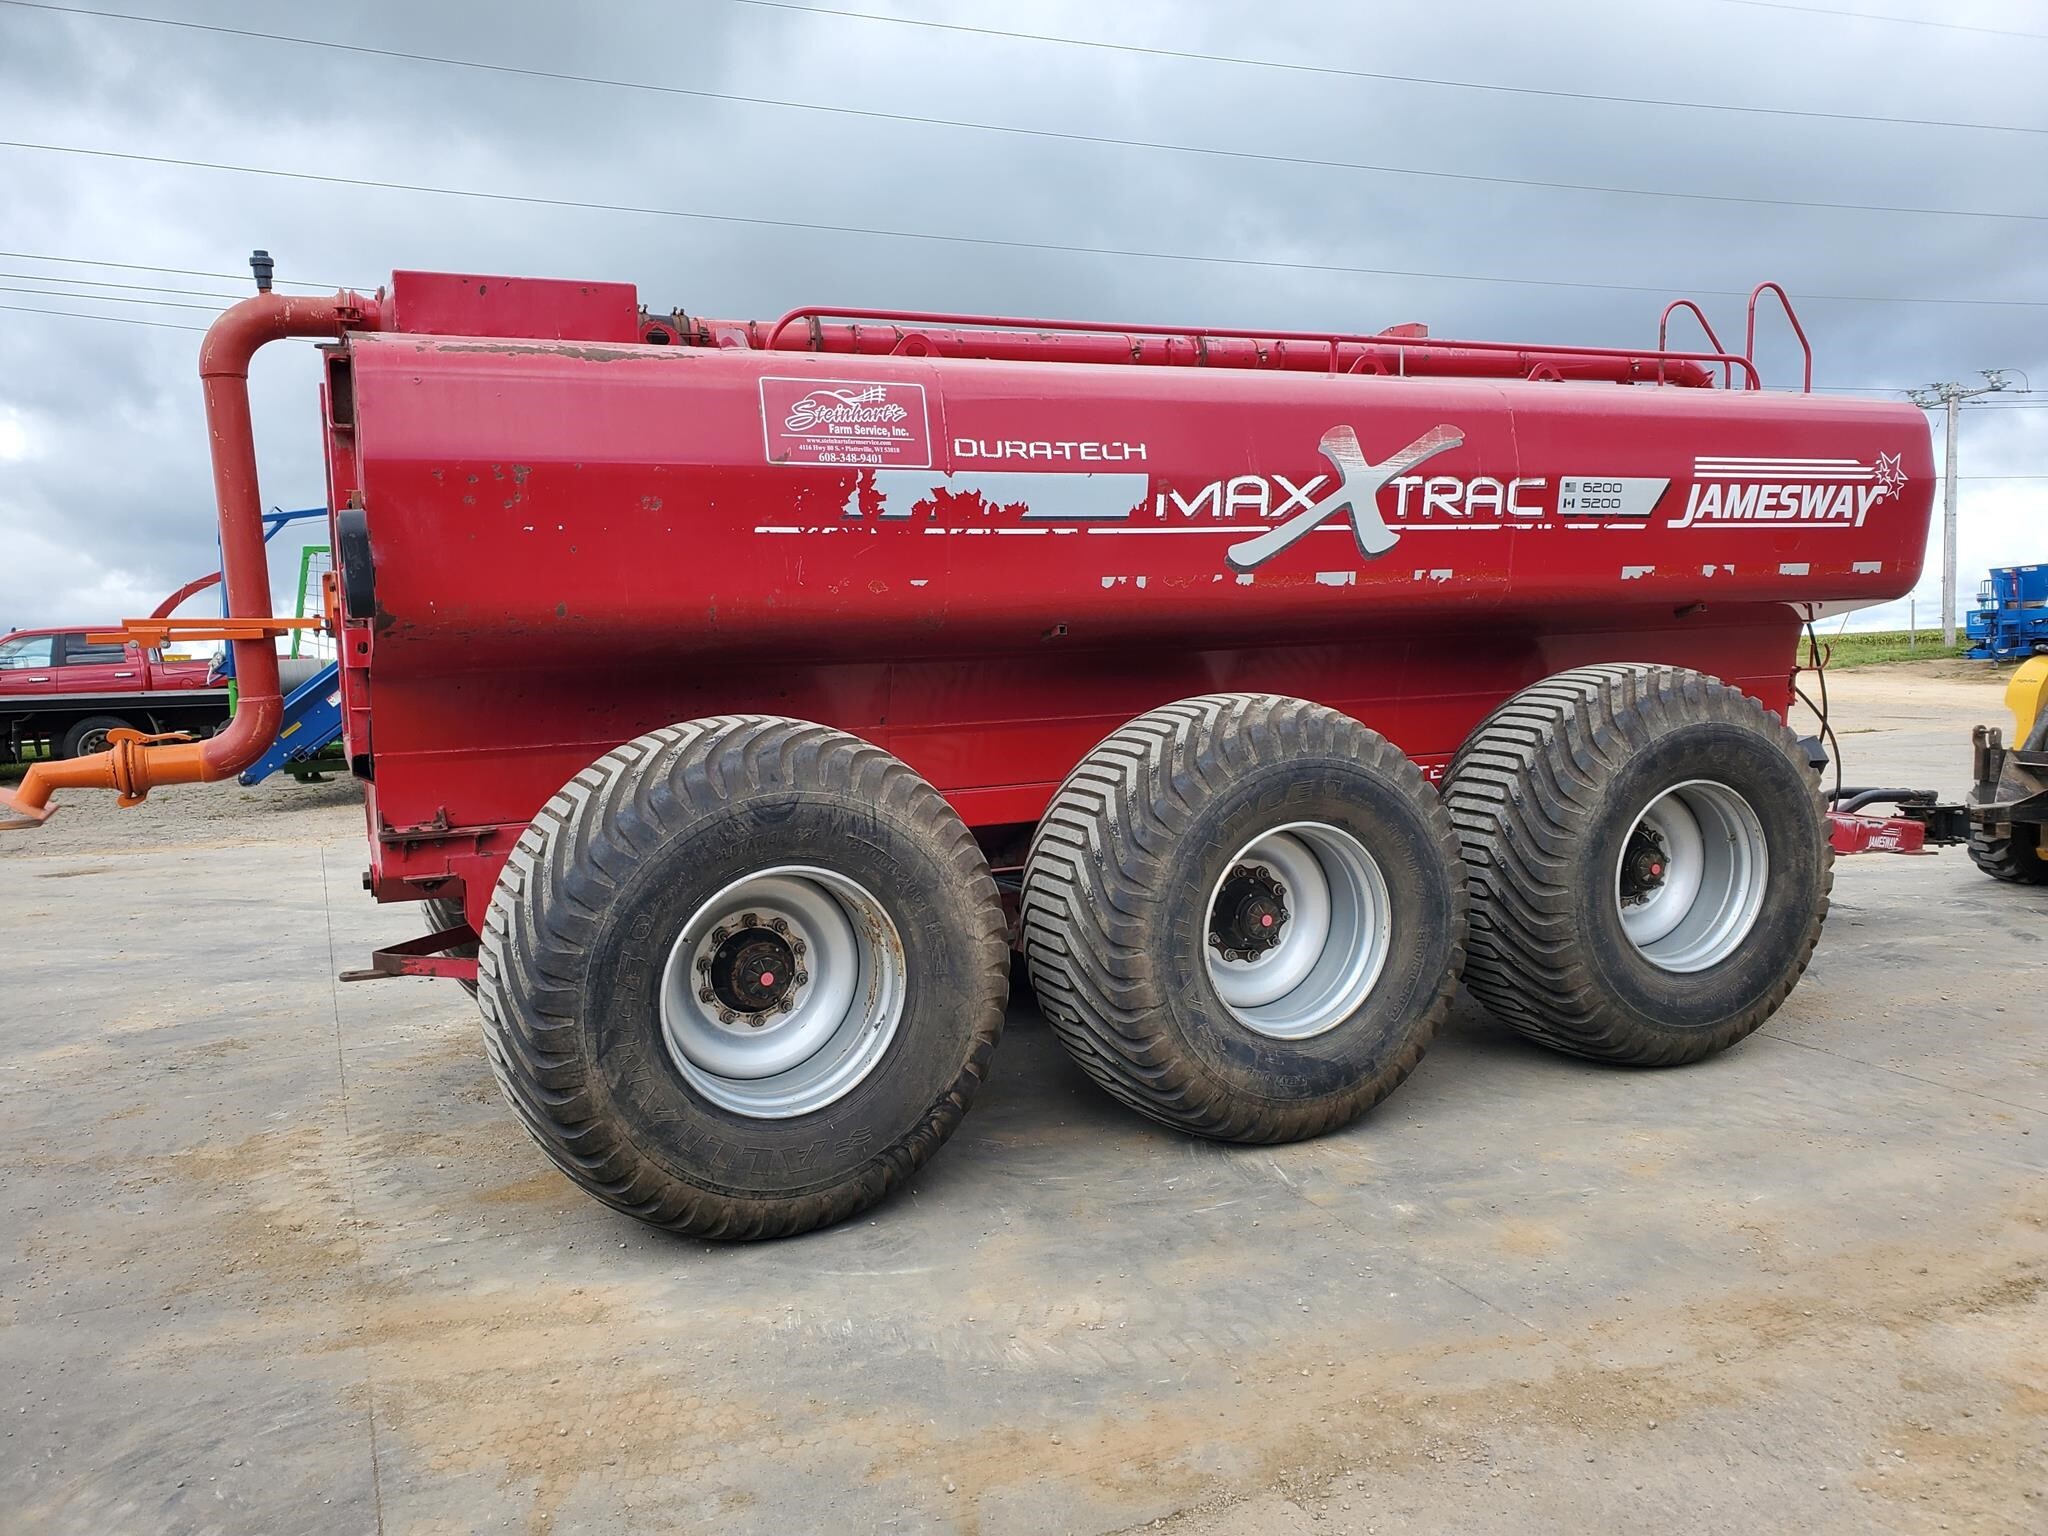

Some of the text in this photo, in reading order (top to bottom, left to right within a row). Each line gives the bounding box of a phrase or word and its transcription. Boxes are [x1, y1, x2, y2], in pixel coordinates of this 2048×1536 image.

[785, 399, 908, 432] Steinhart's
[829, 423, 909, 438] Farm Service, Inc.
[812, 444, 826, 453] Hwy
[953, 438, 1148, 461] DURA-TECH
[818, 453, 883, 464] 608-348-9401
[1582, 481, 1623, 494] 6200
[1580, 497, 1622, 510] 5200
[1667, 483, 1888, 529] JAMESWAY
